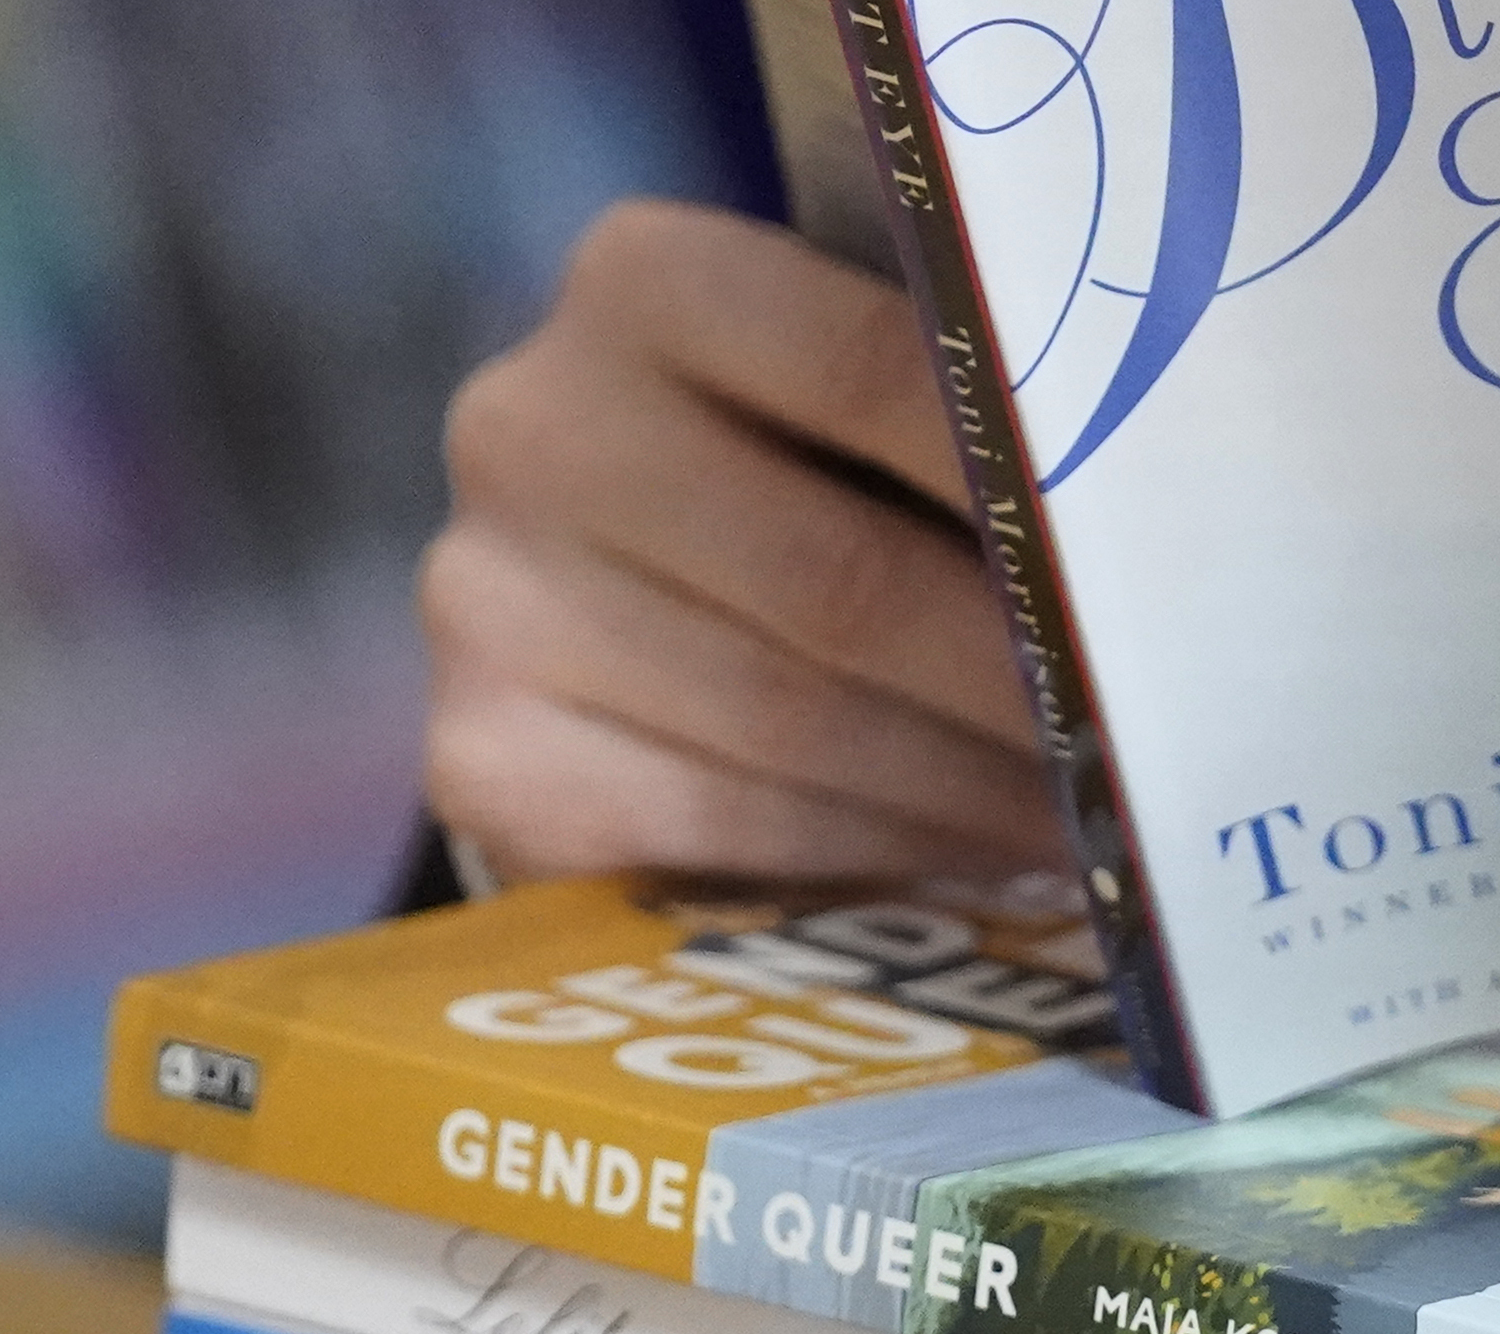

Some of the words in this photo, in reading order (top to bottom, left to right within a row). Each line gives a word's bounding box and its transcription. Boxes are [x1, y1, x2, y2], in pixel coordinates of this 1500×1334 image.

[864, 62, 934, 213] EYE
[938, 327, 1004, 461] Toni
[436, 1107, 739, 1245] GENDER
[761, 1190, 1020, 1318] QUEER
